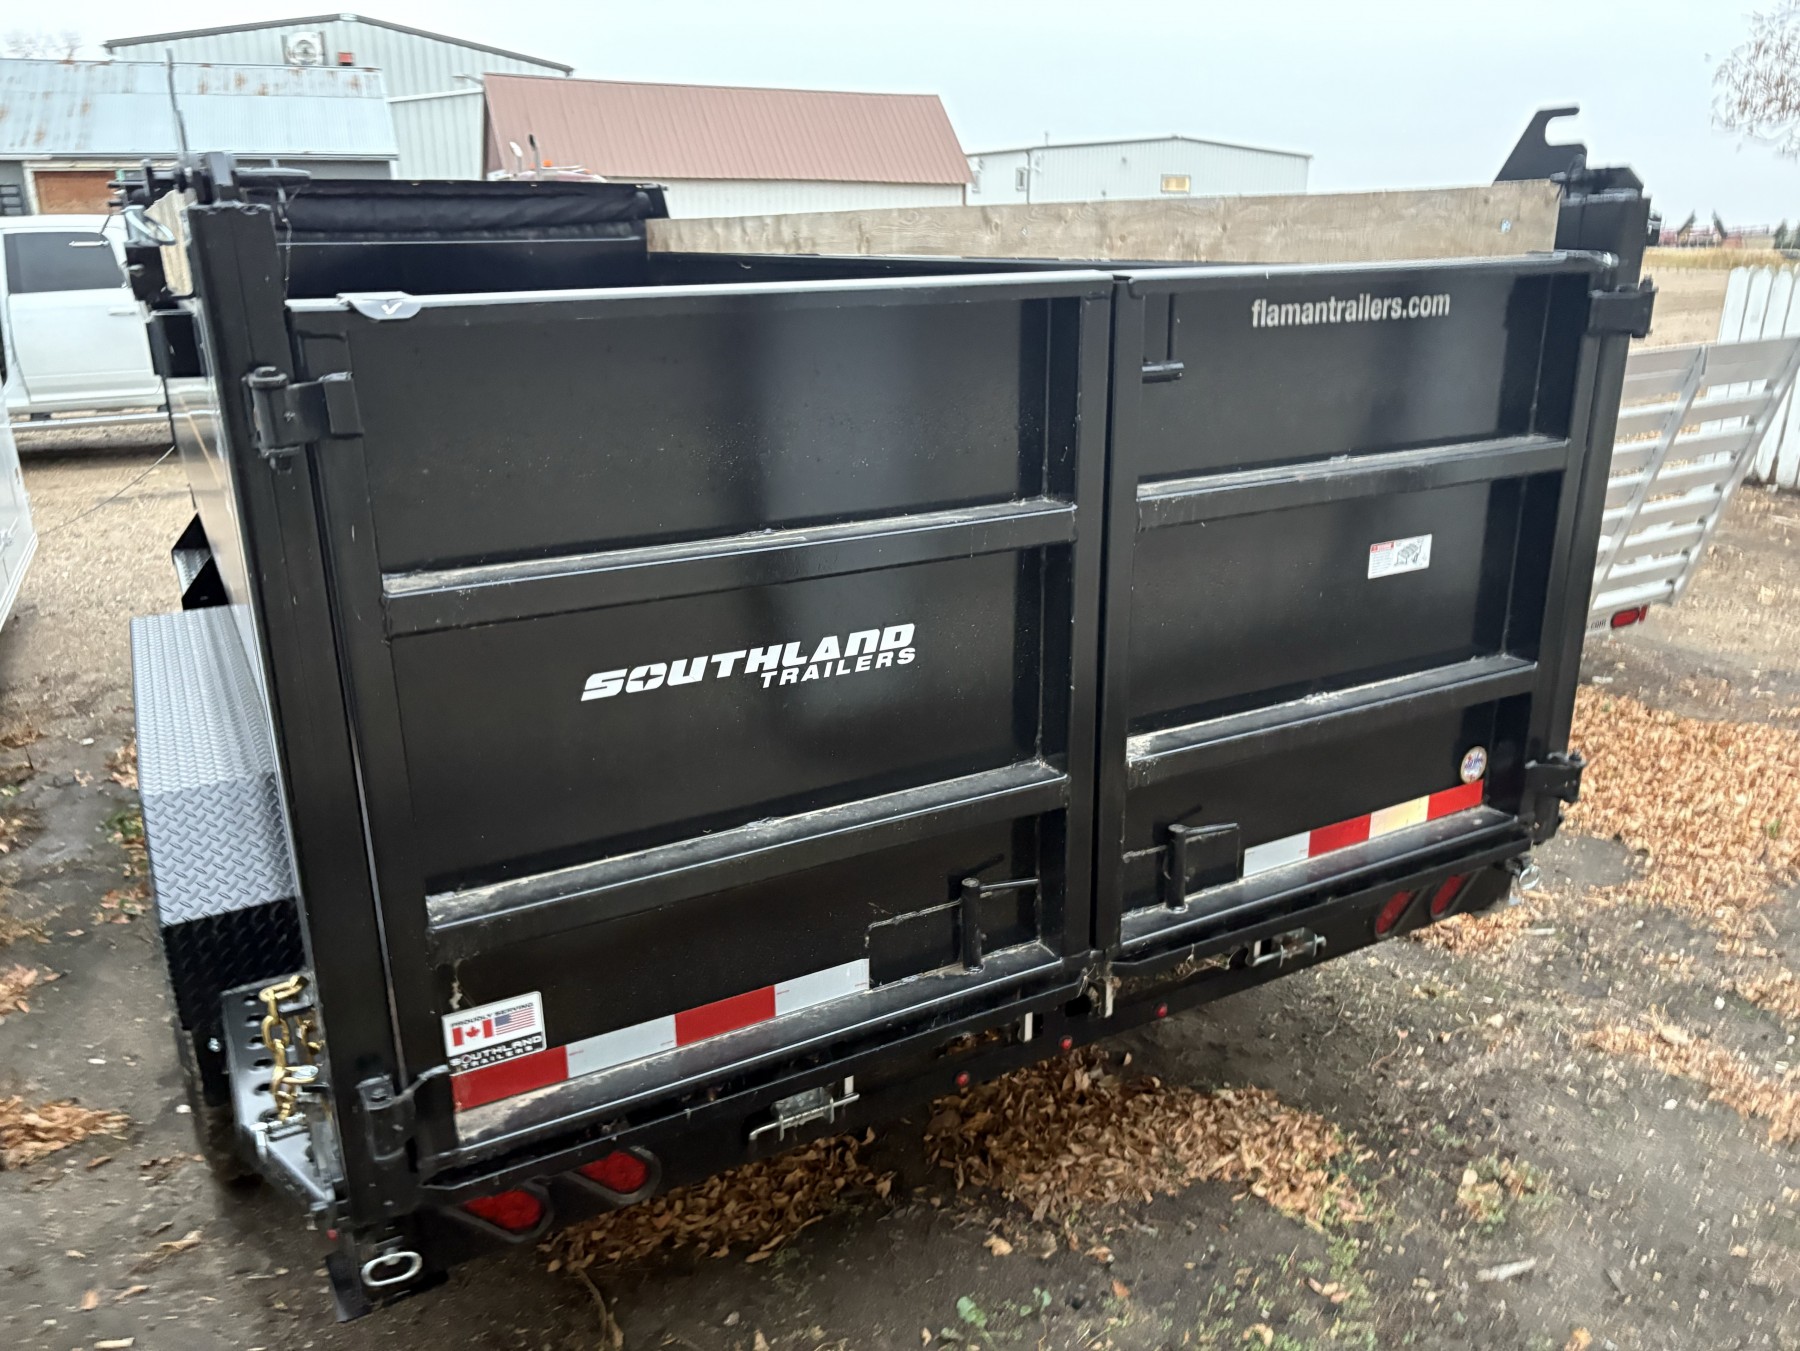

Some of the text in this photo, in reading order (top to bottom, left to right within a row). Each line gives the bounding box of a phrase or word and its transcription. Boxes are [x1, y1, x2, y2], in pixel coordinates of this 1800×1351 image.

[1252, 293, 1450, 328] flamantrailers.com
[581, 623, 916, 701] SOUTHLAND
[761, 647, 916, 688] TRAILERS
[450, 1002, 534, 1027] PROUDLY SERVING
[449, 1035, 542, 1066] SOUTHLAND
[462, 1045, 534, 1069] TRAILERS
